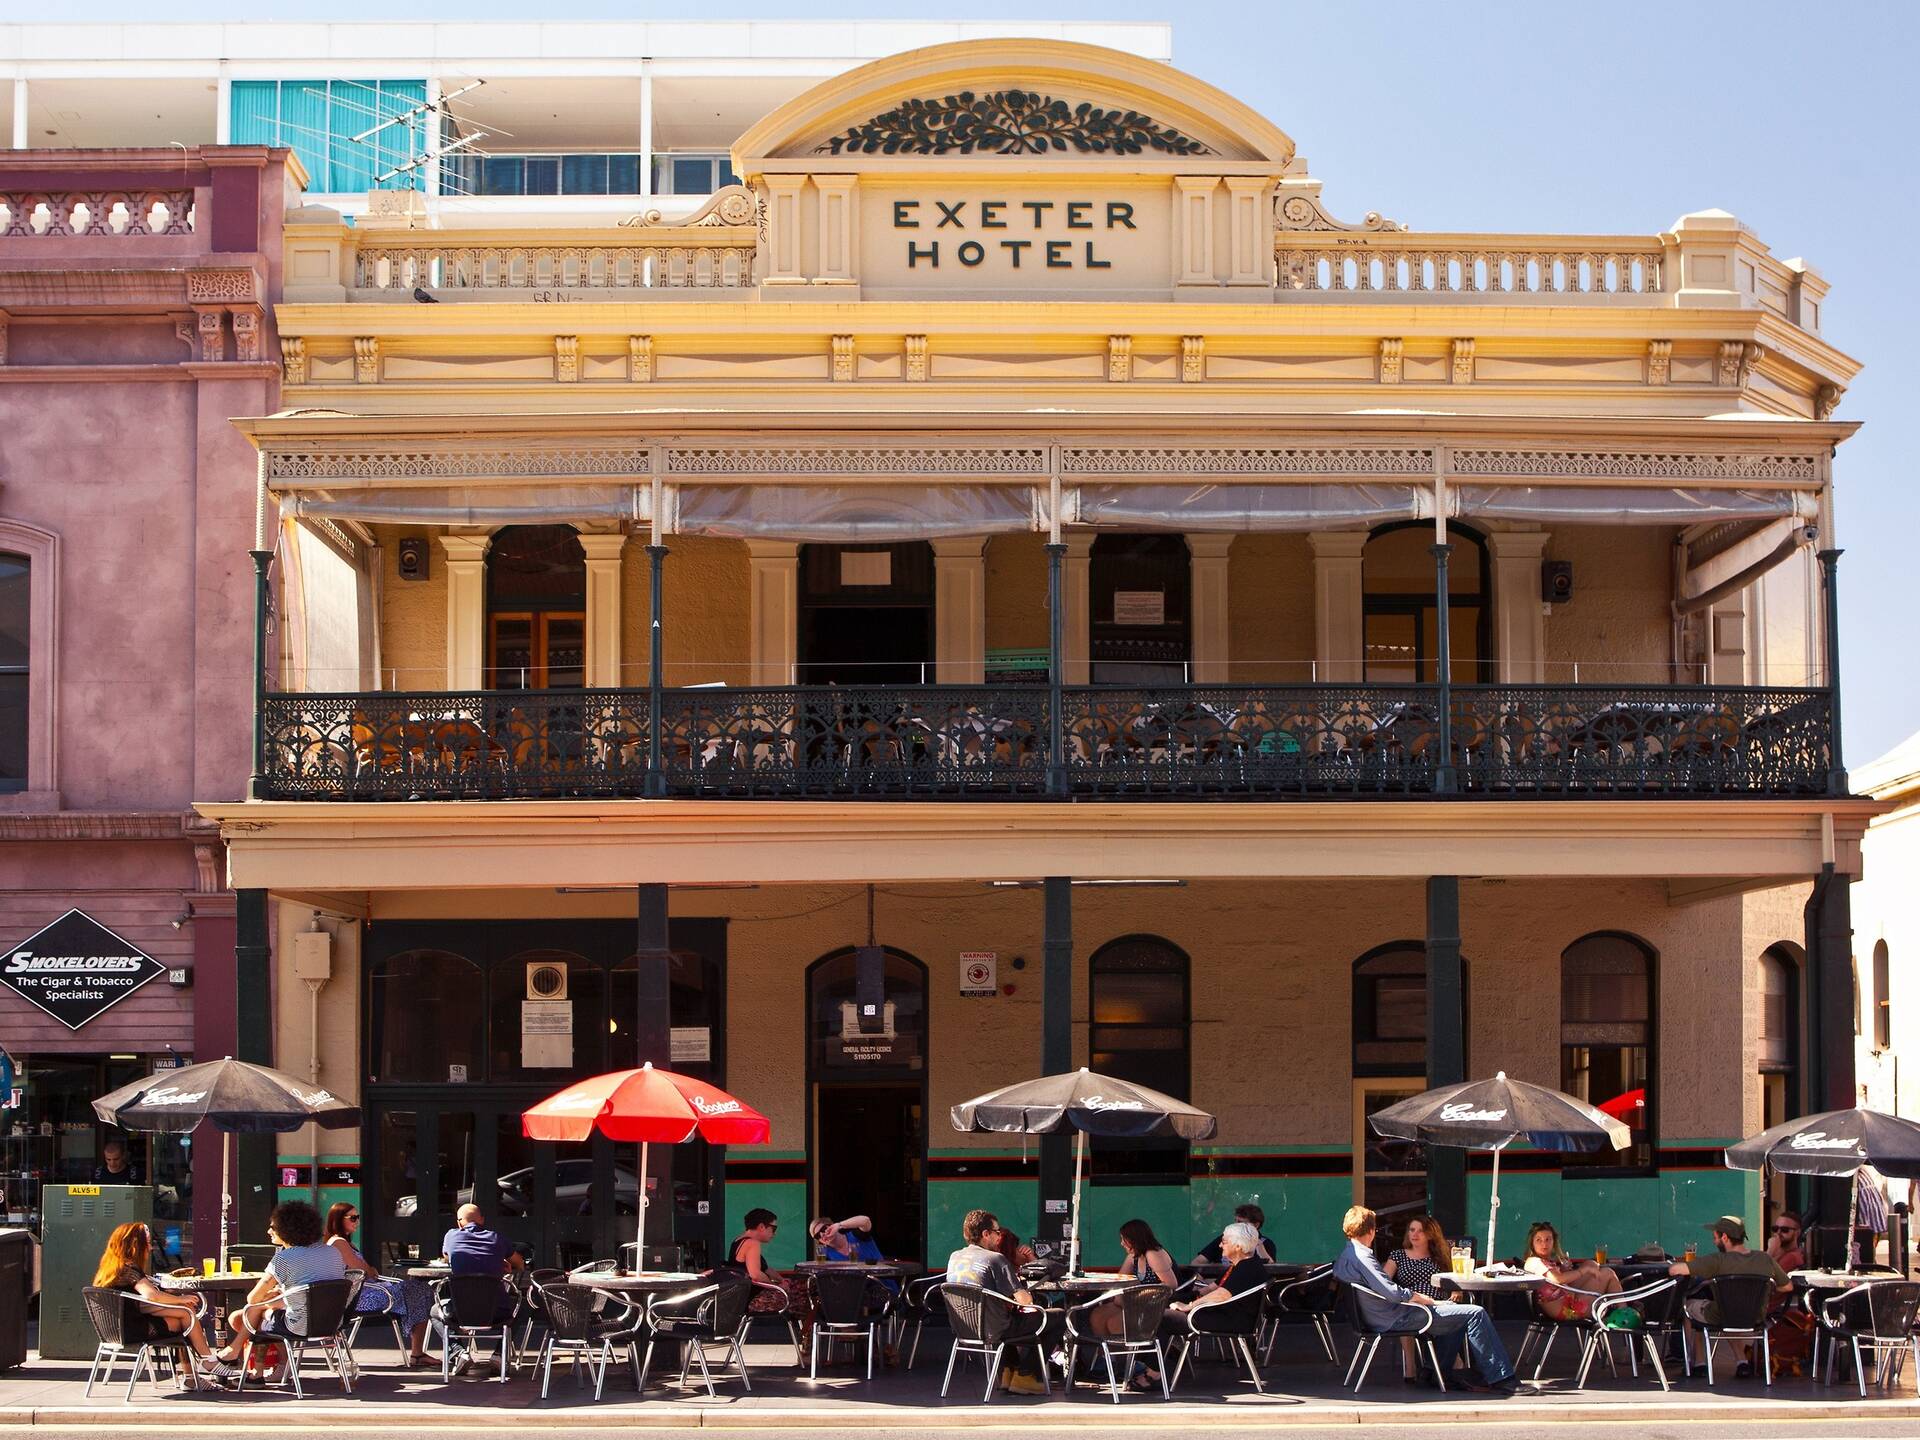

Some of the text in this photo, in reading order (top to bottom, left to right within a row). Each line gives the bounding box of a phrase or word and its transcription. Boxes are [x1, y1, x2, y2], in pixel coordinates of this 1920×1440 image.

[893, 201, 1137, 229] EXETER
[908, 240, 1112, 268] HOTEL
[4, 951, 144, 973] SMOKELOVERS
[16, 976, 134, 988] The Cigar & Tobacco
[46, 990, 104, 1002] Specialists
[689, 1096, 743, 1115] Coopers
